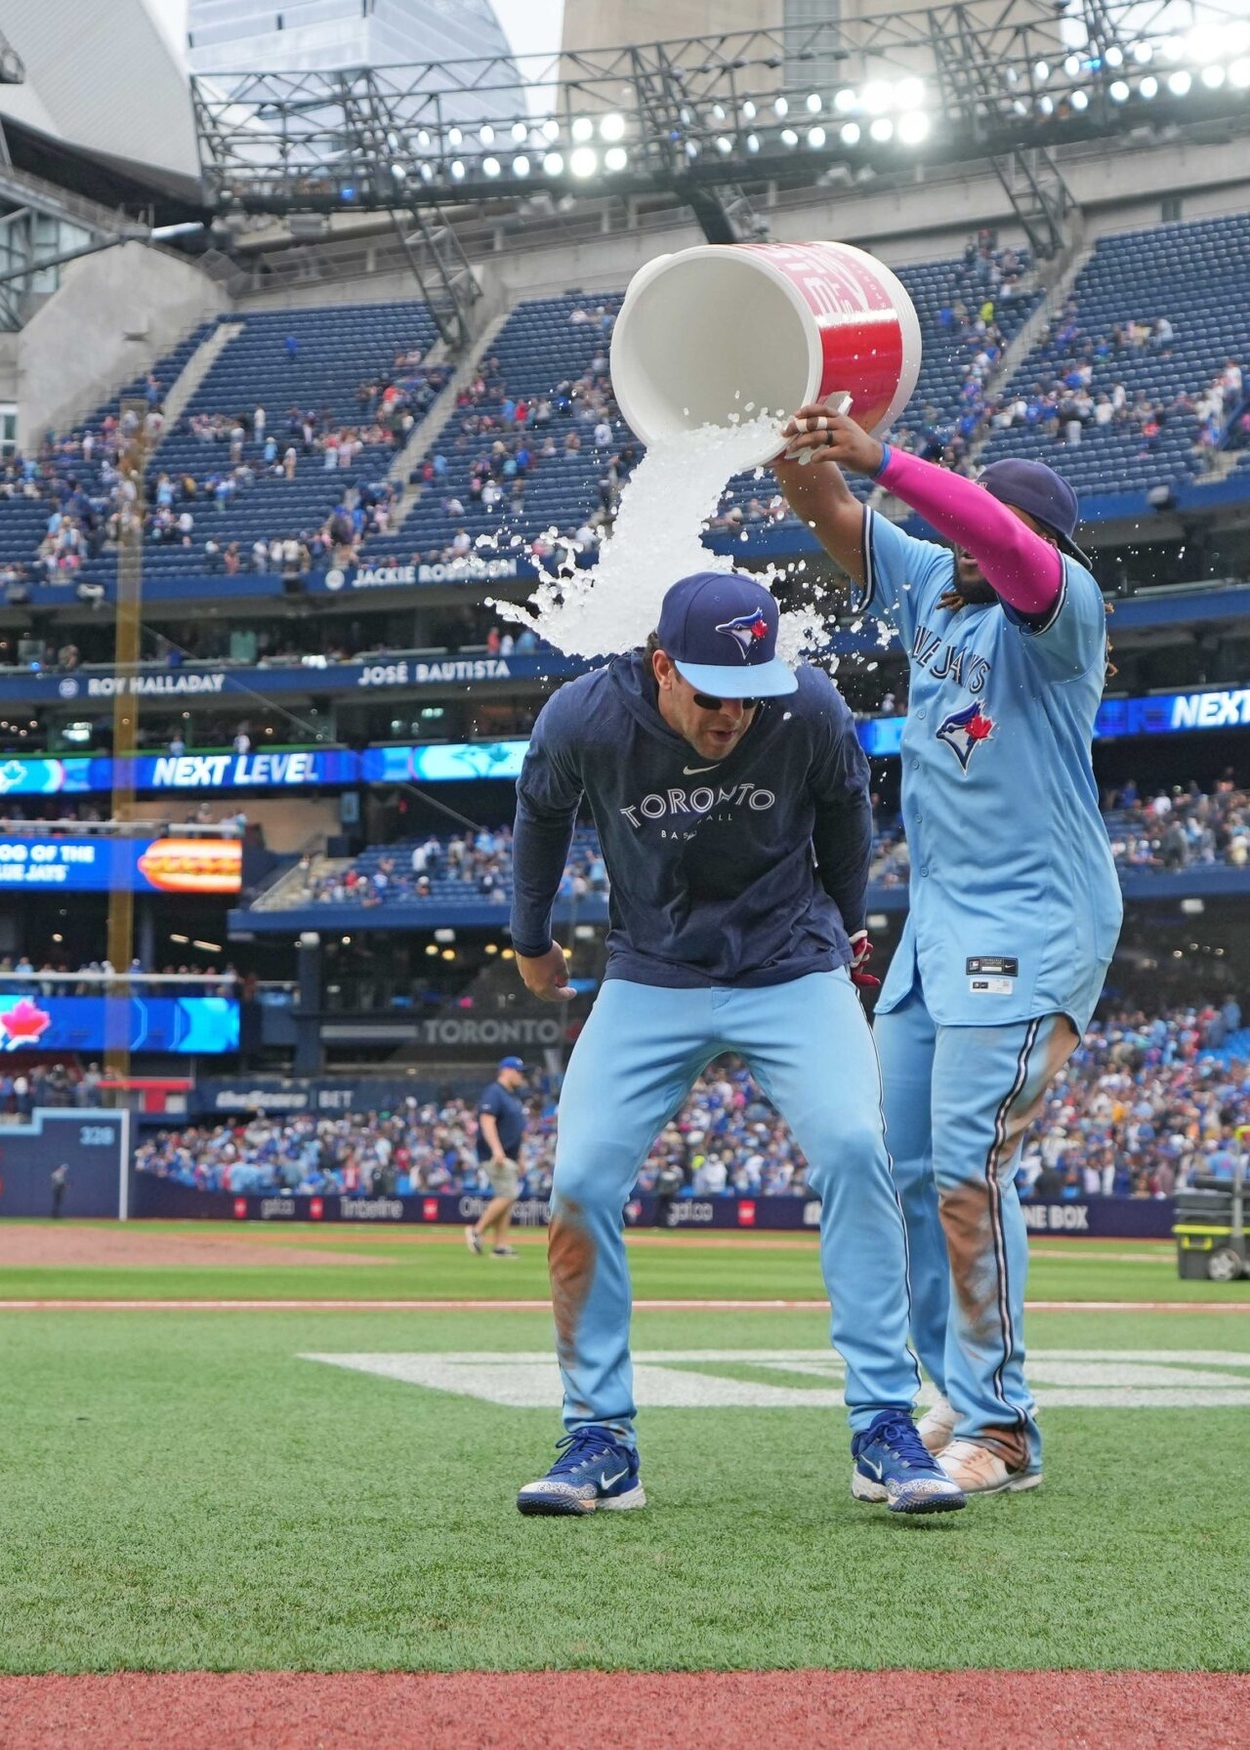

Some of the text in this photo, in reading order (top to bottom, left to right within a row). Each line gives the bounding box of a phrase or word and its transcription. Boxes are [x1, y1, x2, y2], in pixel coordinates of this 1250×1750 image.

[352, 567, 415, 588] JACKIE
[358, 660, 510, 685] JOSÉ BAUTISTA
[88, 677, 126, 696] ROY
[129, 674, 225, 694] HALLADAY
[152, 753, 319, 787] NEXT LEVEL
[620, 783, 775, 829] TORONTO
[31, 844, 58, 862] OF
[60, 845, 95, 863] THE
[25, 864, 70, 882] JAYS
[424, 1019, 559, 1043] TORONTO
[319, 1090, 354, 1107] BET
[340, 1196, 404, 1219] Timberline
[1048, 1204, 1089, 1229] BOX
